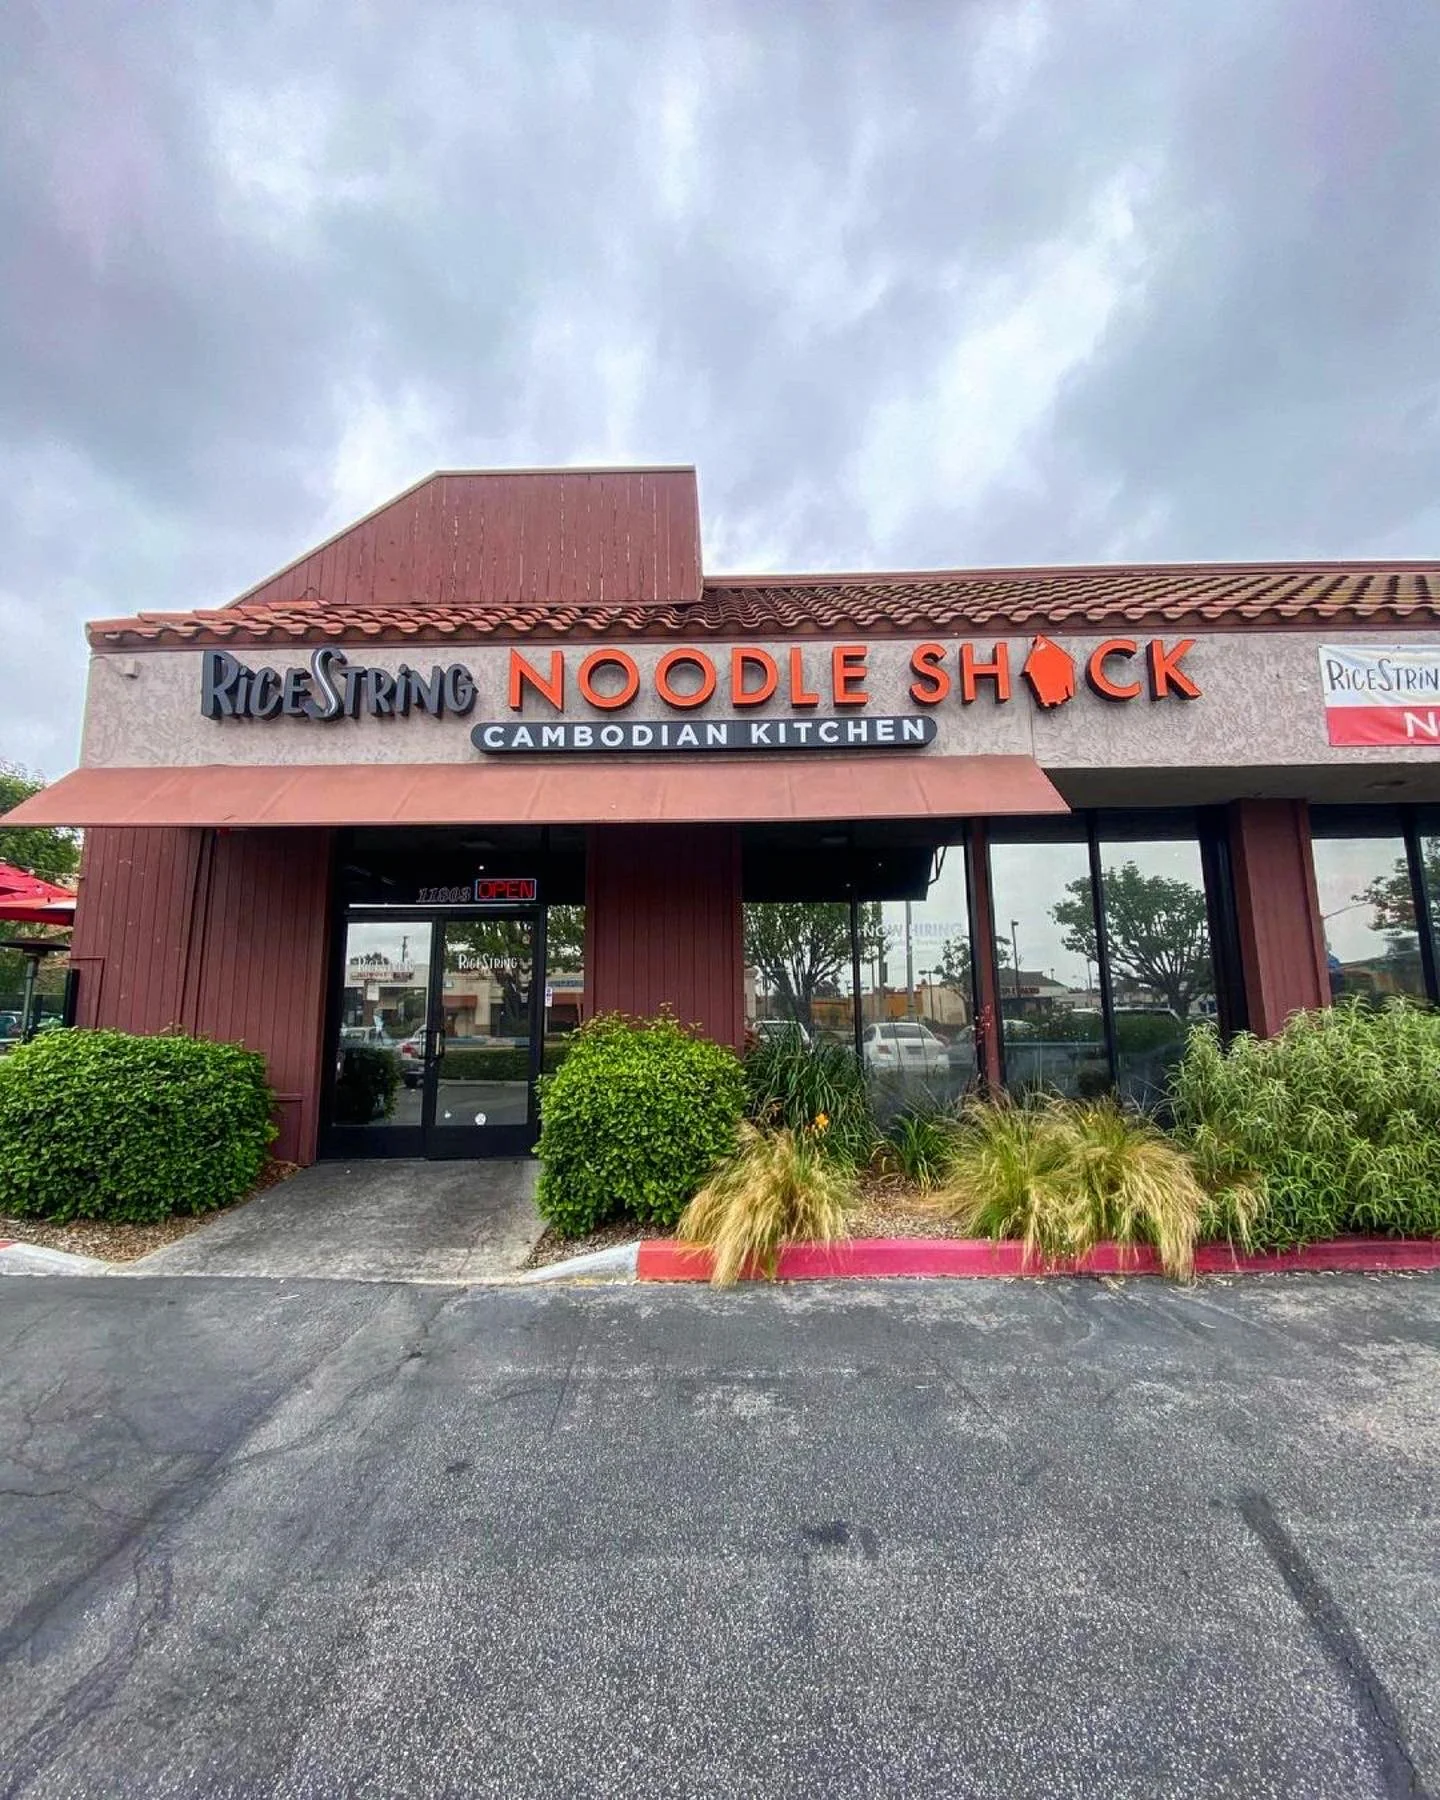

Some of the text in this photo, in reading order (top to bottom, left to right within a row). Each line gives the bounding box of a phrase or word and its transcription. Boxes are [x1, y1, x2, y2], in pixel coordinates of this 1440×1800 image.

[507, 644, 869, 713] NOODLE
[482, 718, 926, 749] CAMBODIAN KITCHEN
[478, 881, 534, 899] OPEN
[862, 922, 904, 938] NOW
